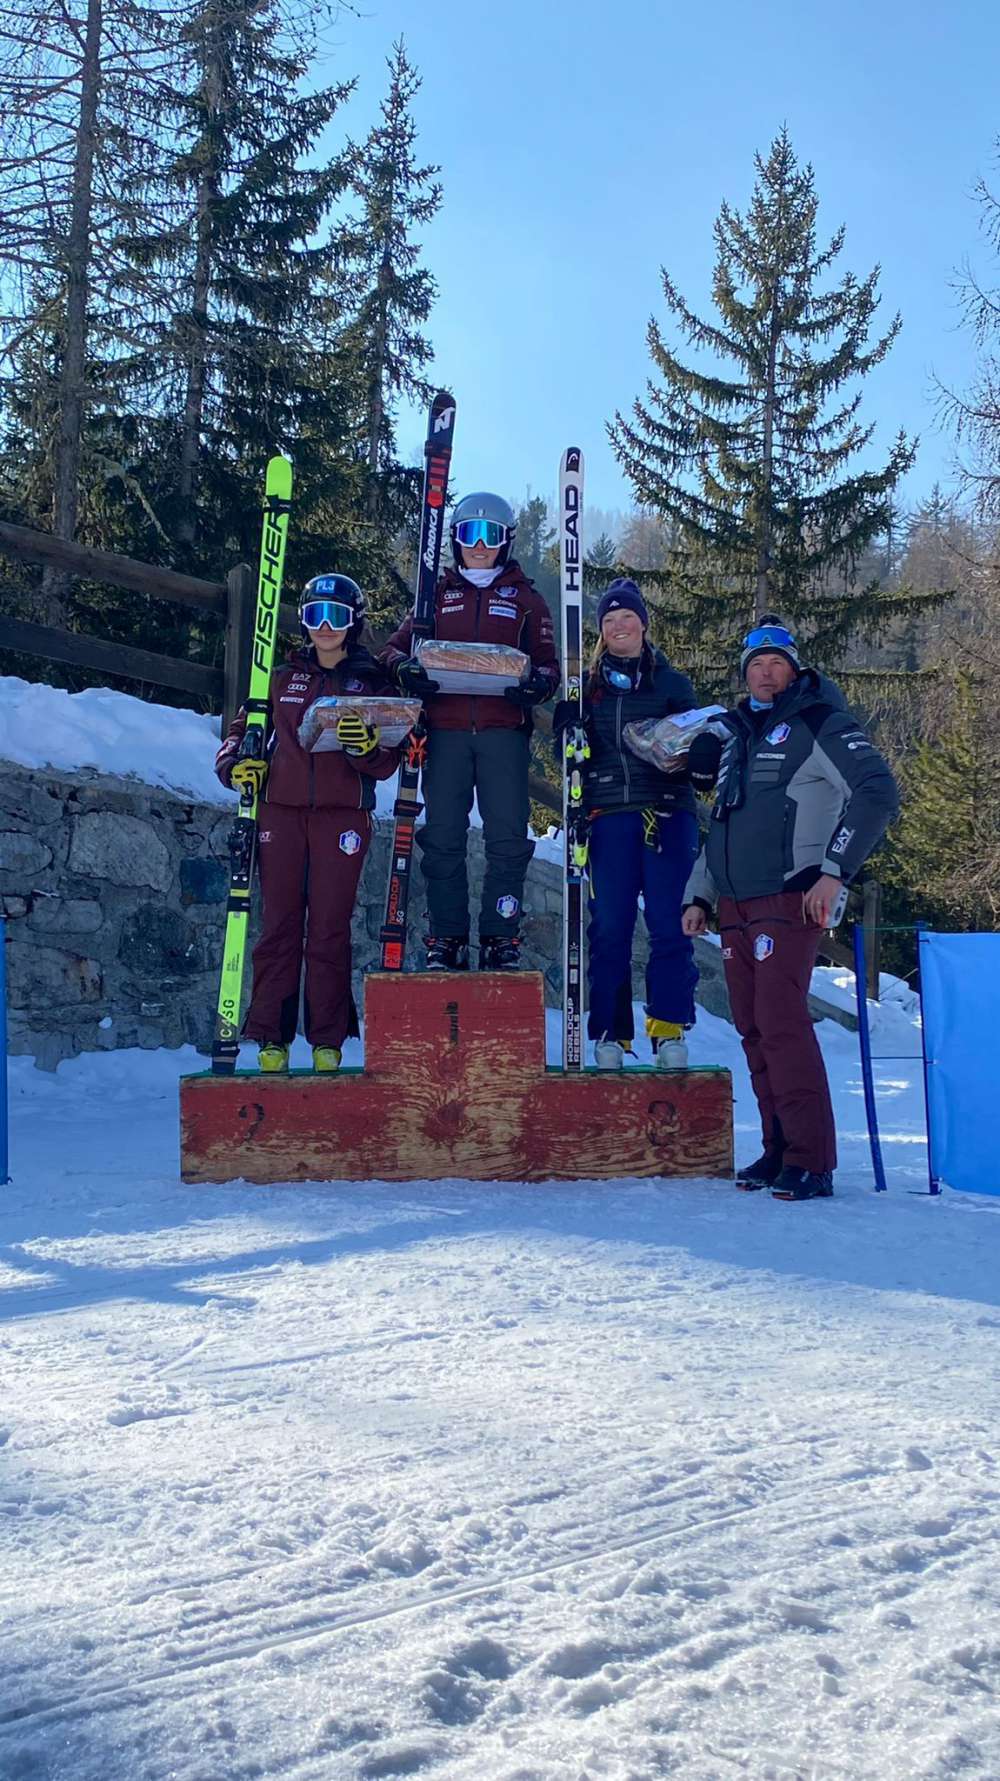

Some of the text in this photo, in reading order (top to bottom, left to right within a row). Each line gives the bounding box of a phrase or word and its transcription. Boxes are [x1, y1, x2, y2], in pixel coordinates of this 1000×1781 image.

[422, 508, 439, 572] NORDICA
[565, 484, 580, 592] HEAD
[253, 502, 283, 674] FISCHER
[831, 826, 851, 853] EA7
[396, 910, 405, 923] SG
